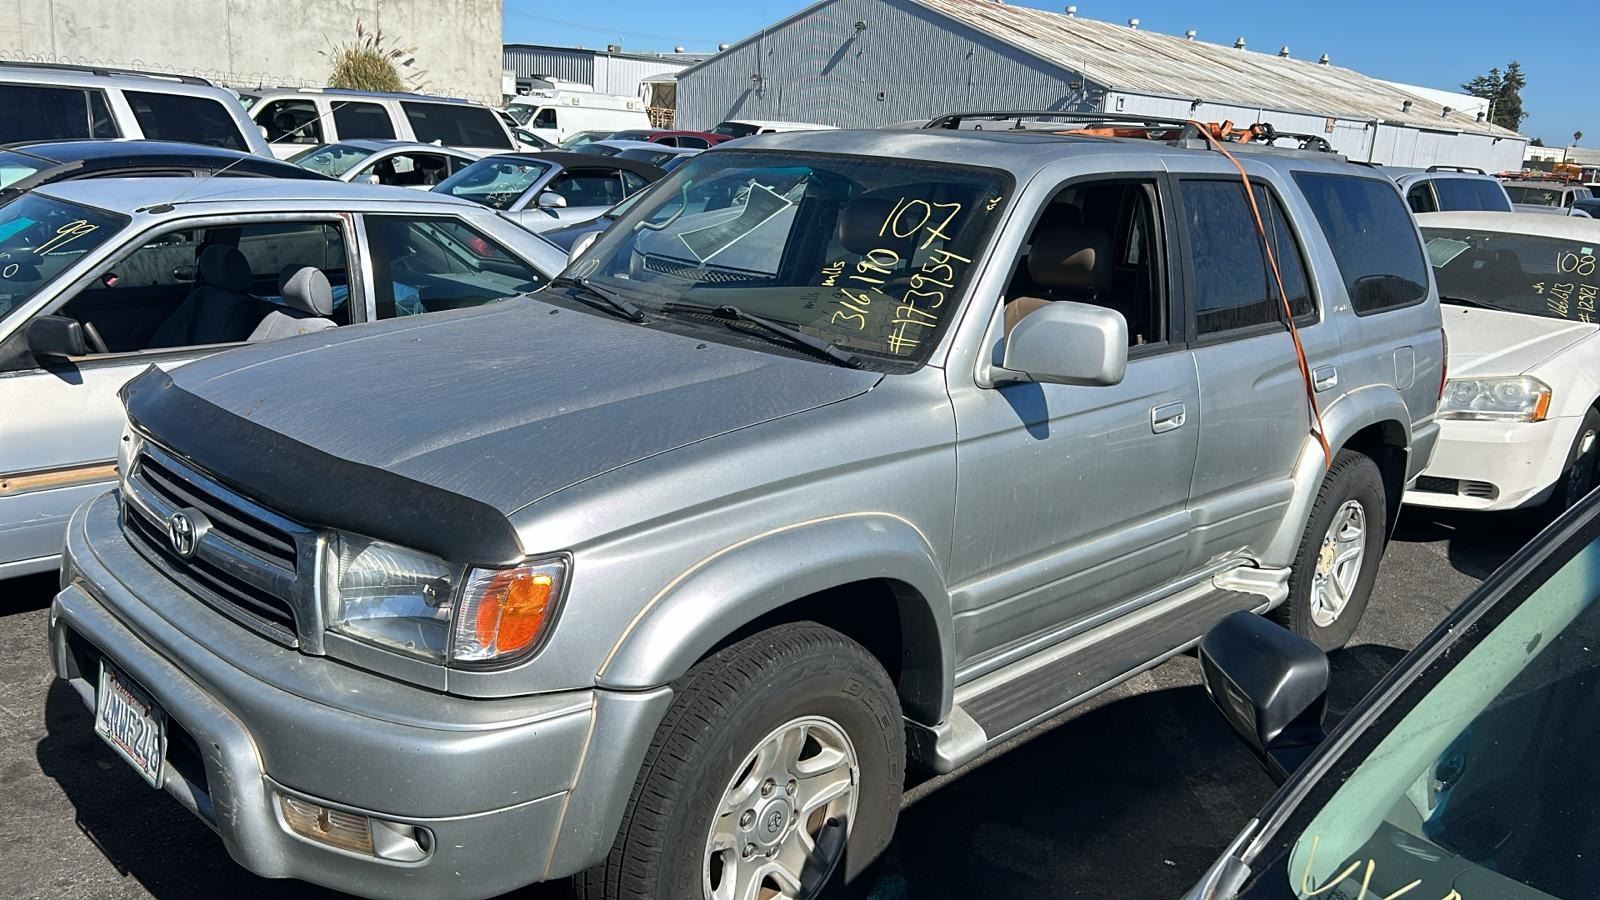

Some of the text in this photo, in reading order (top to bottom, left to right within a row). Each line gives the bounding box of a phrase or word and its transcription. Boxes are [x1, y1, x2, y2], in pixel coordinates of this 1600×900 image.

[33, 219, 100, 256] 99
[878, 196, 961, 250] 107
[1556, 251, 1597, 276] 108
[831, 248, 899, 330] 316,190
